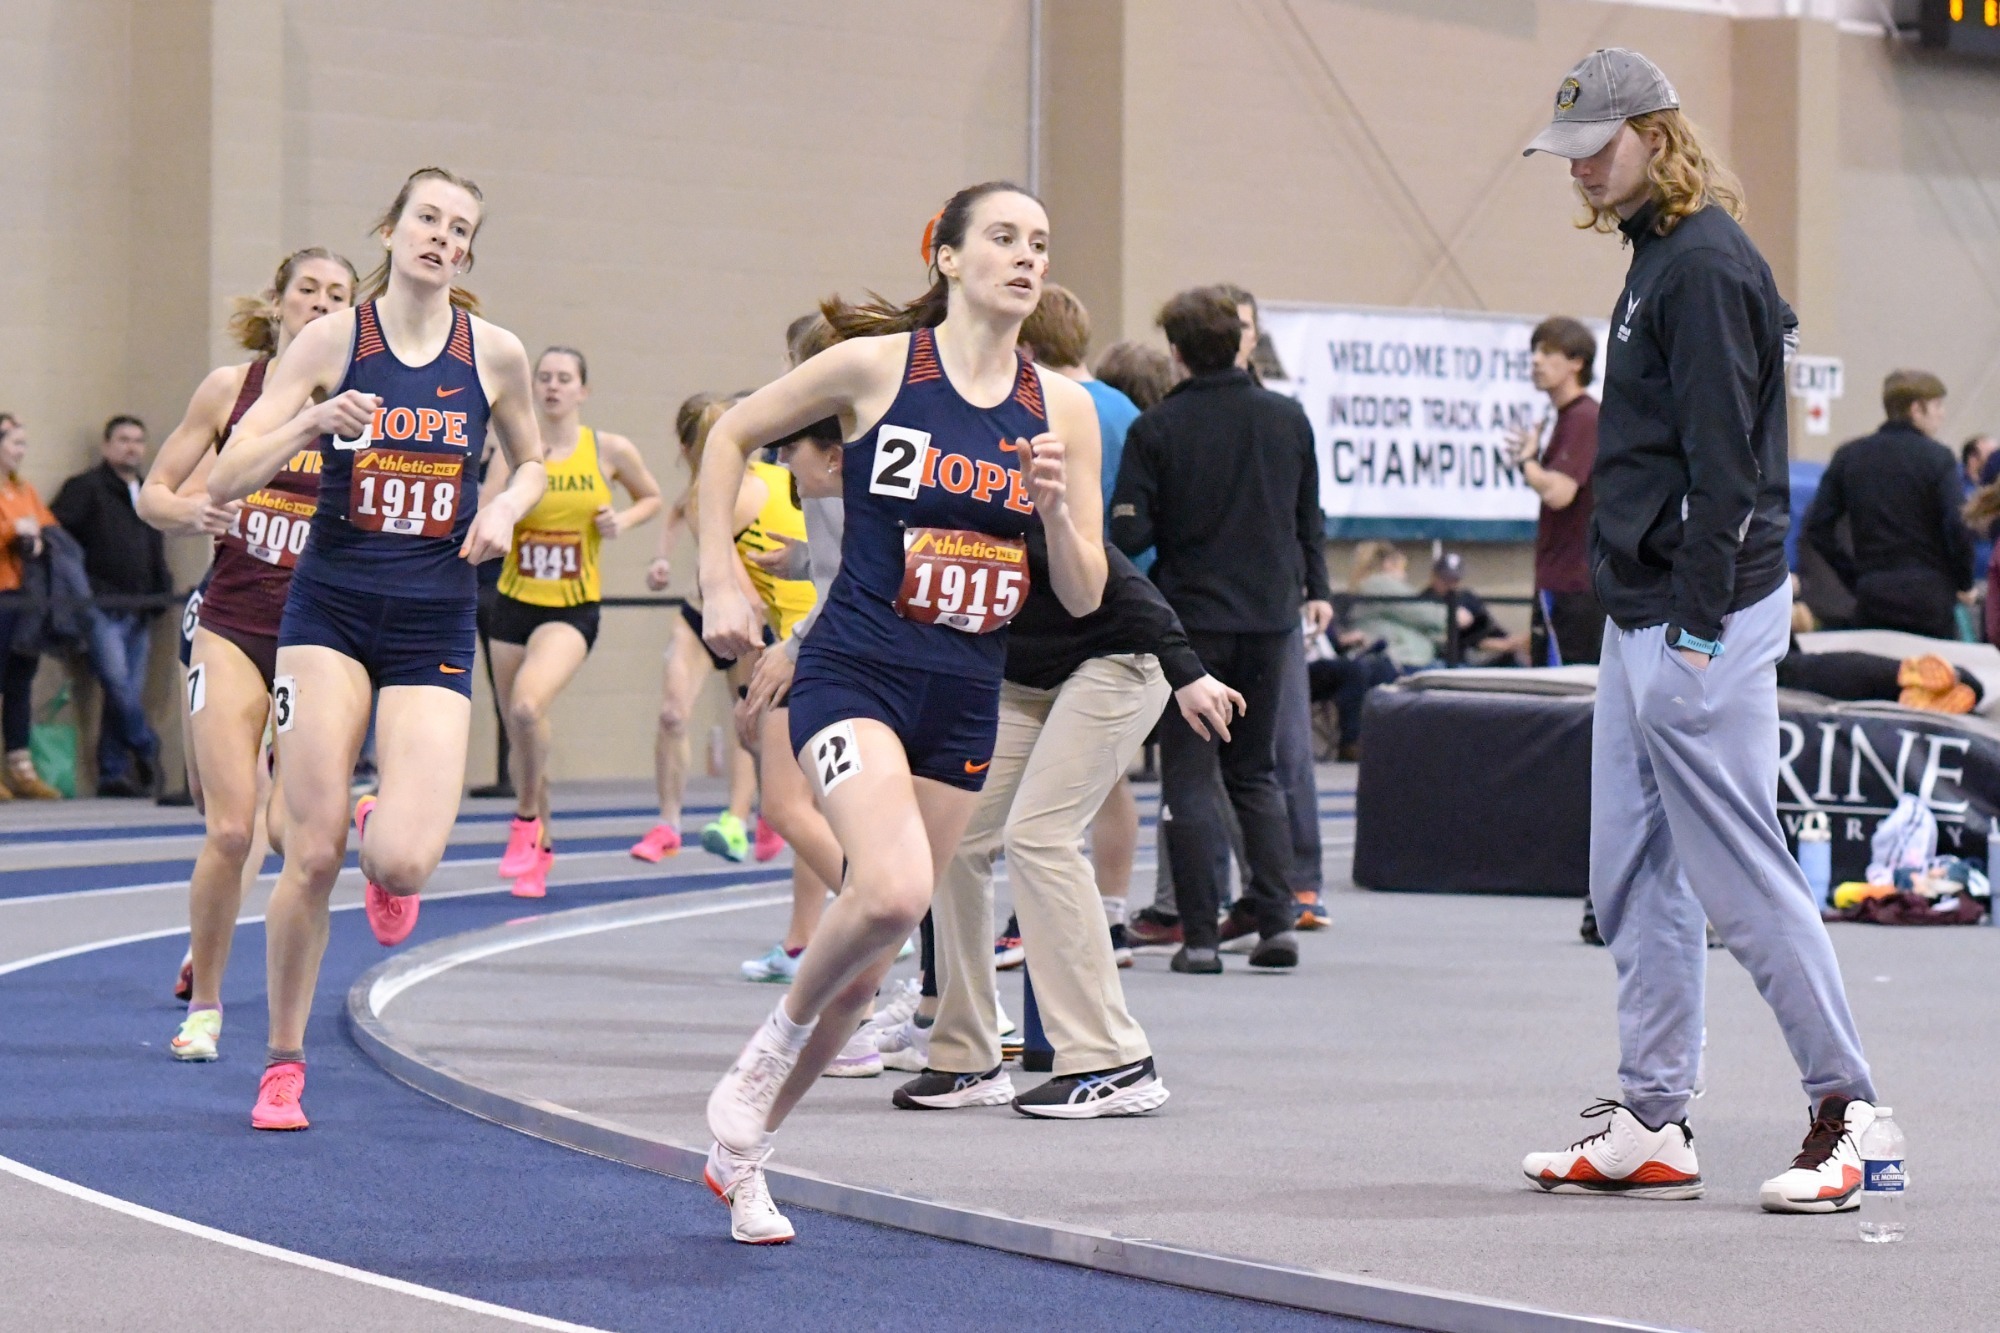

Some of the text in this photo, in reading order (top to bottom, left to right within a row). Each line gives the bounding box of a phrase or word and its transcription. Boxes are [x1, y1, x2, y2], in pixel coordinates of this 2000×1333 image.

[1328, 340, 1532, 381] WELCOME TO THE
[1796, 363, 1839, 390] EXIT
[1329, 395, 1411, 428] INDOOR
[1422, 398, 1483, 431] TRACK
[356, 452, 433, 475] Athletic
[875, 438, 917, 489] 2
[1332, 439, 1528, 488] CHAMPION
[246, 490, 294, 512] thletic
[357, 476, 455, 522] 1918
[228, 510, 311, 555] 1900
[910, 532, 996, 559] Athletic
[520, 542, 577, 573] 1841
[908, 562, 1022, 617] 1915
[188, 668, 200, 712] 7
[276, 686, 290, 727] 3
[818, 735, 852, 787] 2
